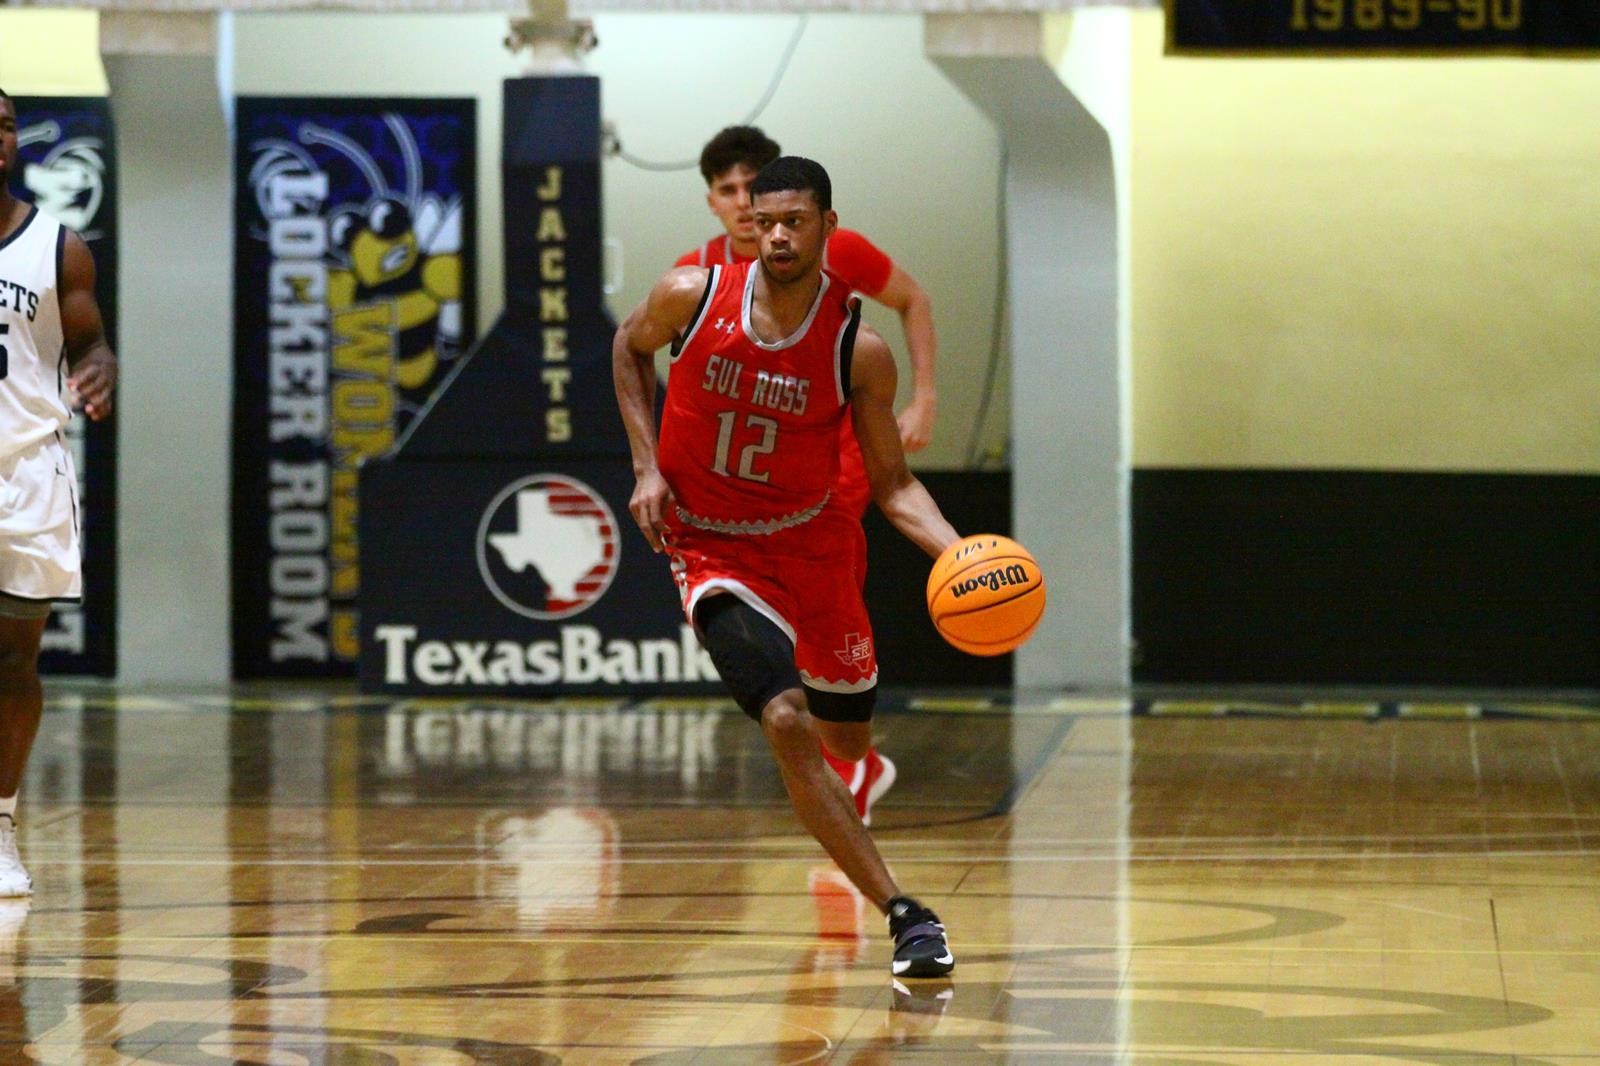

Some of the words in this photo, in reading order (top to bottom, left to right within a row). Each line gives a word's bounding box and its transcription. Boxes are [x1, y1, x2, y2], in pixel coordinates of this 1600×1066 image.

[270, 172, 329, 443] LOCKER
[536, 165, 572, 443] JACKETS
[702, 354, 743, 399] SUL
[752, 369, 811, 416] ROSS
[710, 410, 778, 483] 12
[269, 459, 329, 662] ROOM
[950, 563, 1029, 598] Wilson
[375, 624, 722, 684] TexasBank
